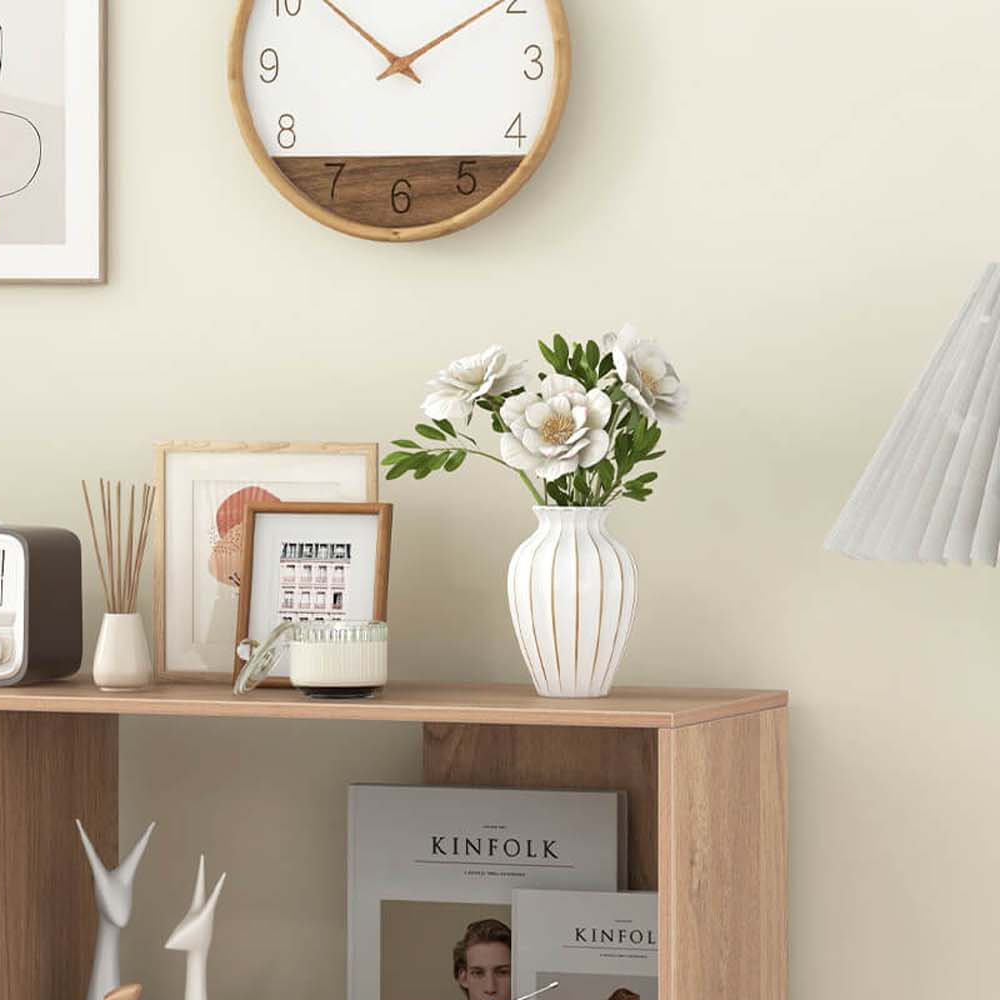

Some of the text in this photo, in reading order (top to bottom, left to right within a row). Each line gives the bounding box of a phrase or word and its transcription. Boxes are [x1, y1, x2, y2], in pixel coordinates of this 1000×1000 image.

[259, 48, 279, 83] 9
[523, 44, 544, 80] 3
[277, 113, 296, 149] 8
[504, 111, 527, 148] 4
[324, 162, 346, 199] 7
[456, 161, 477, 195] 5
[390, 179, 412, 214] 6
[432, 836, 559, 859] KINFOLK
